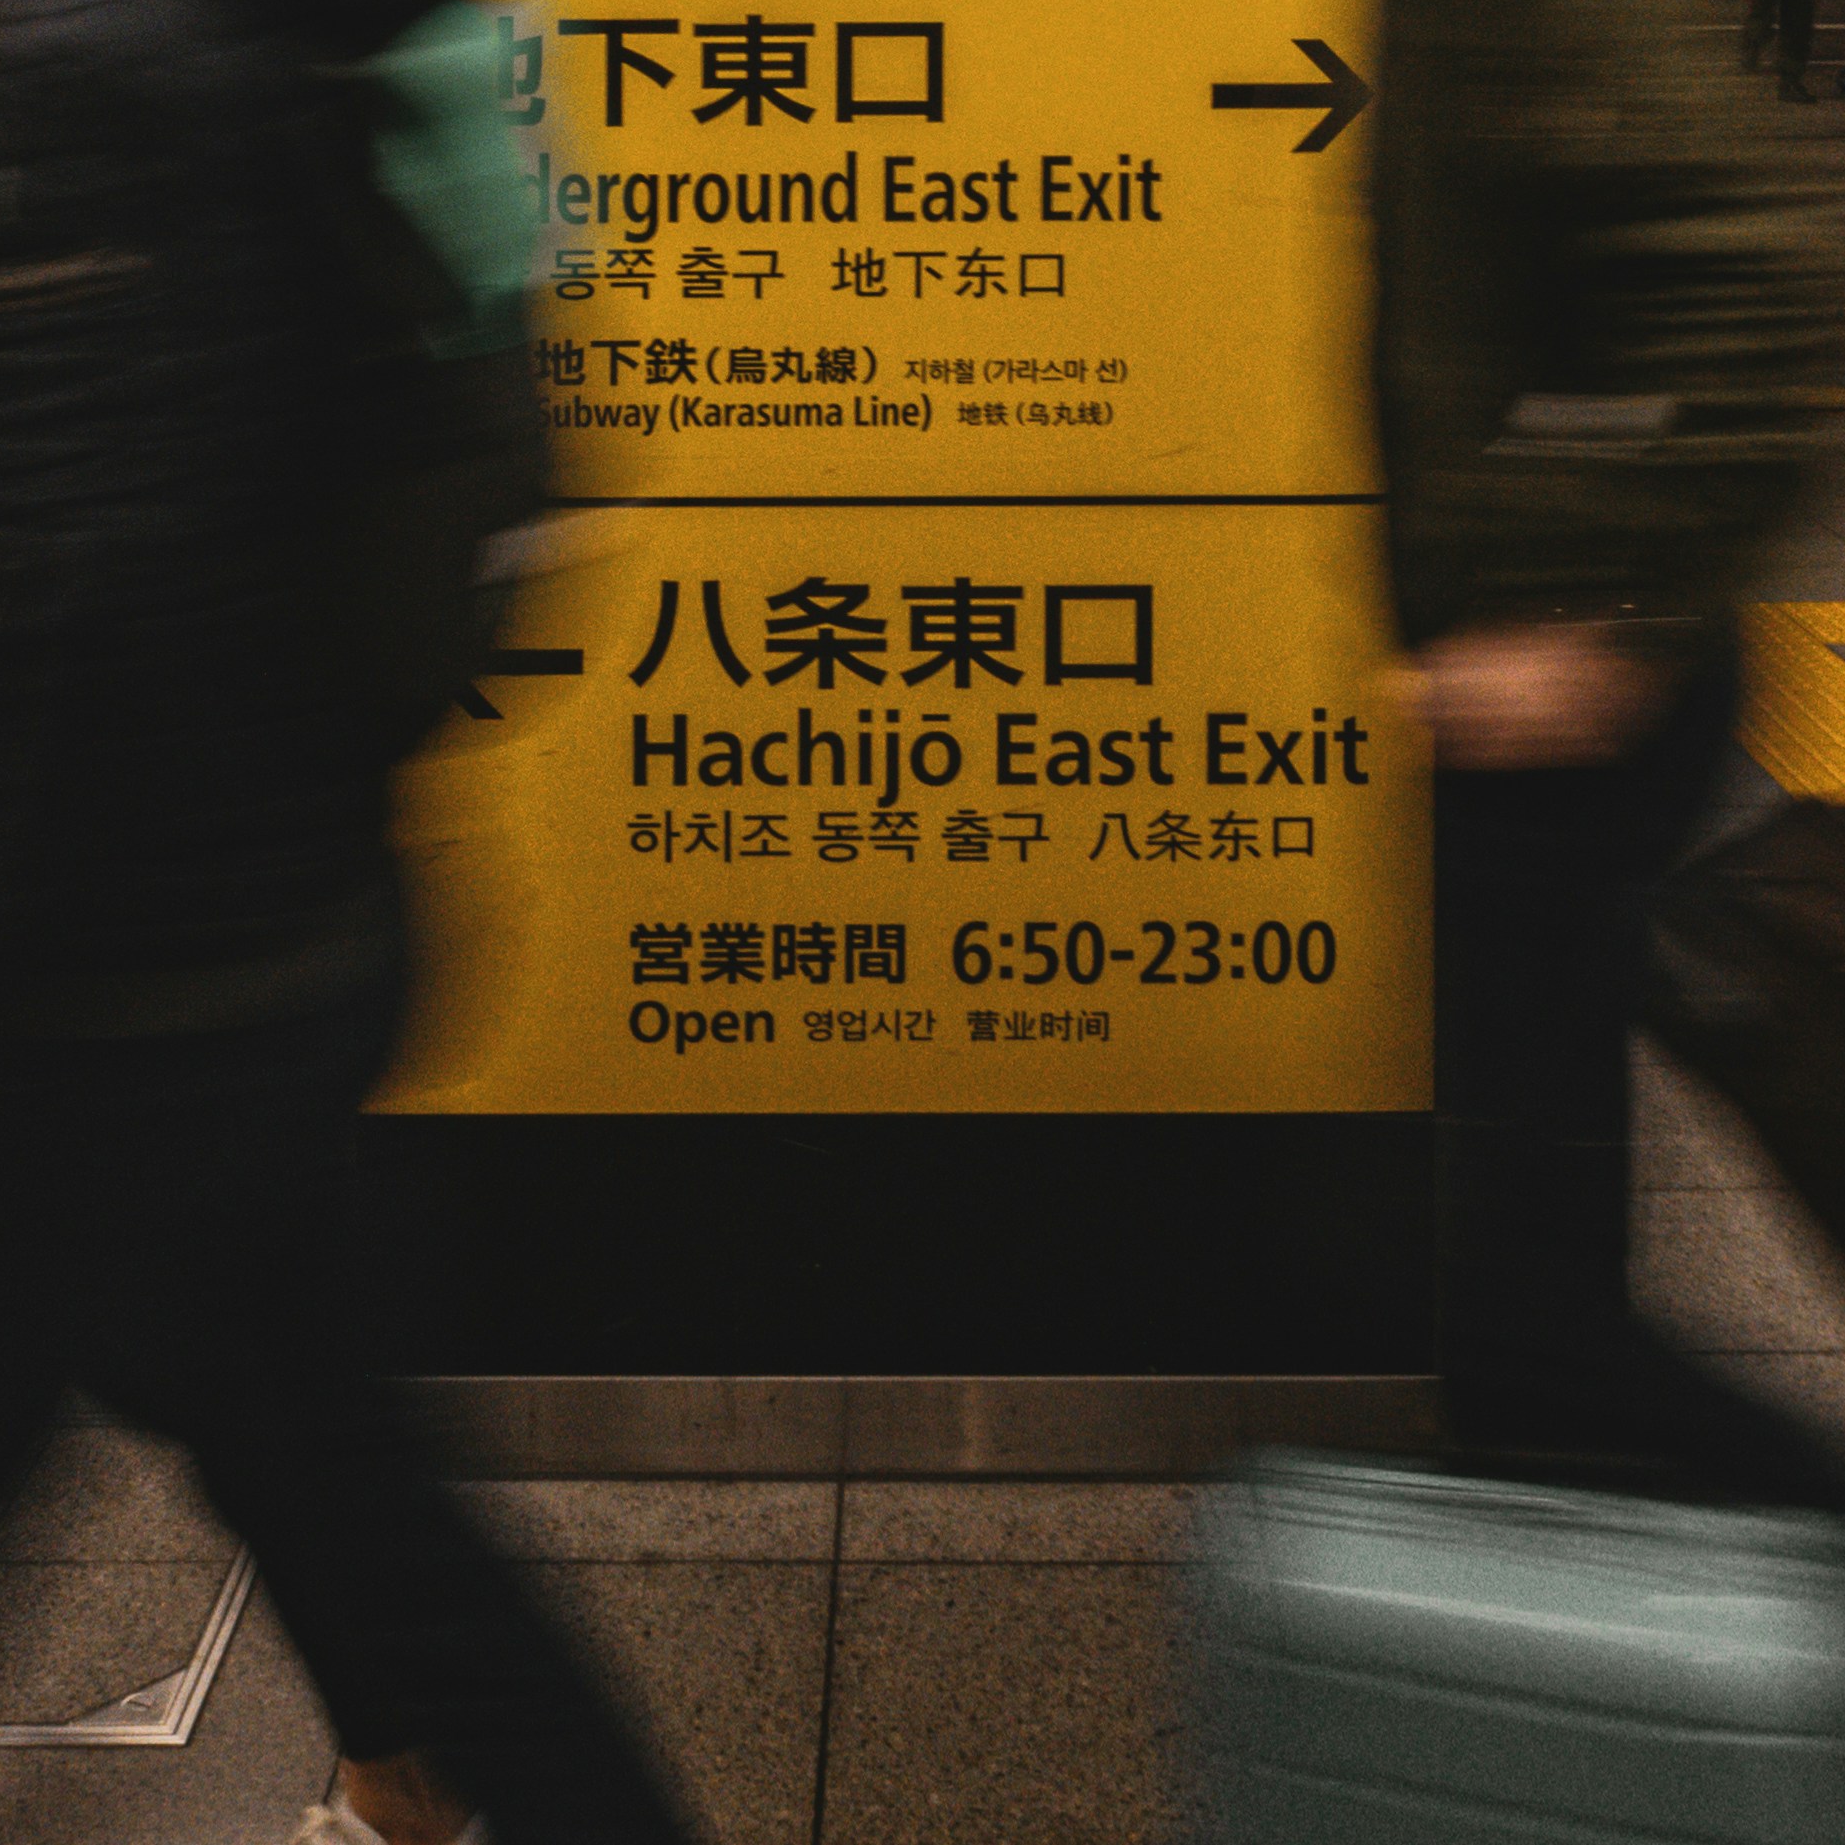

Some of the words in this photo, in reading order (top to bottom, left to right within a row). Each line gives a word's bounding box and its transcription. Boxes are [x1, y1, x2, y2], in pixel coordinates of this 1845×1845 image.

[526, 151, 858, 242] derground
[882, 157, 1017, 226] East
[1040, 152, 1161, 224] Exit
[551, 246, 655, 302] 동쪽
[676, 246, 785, 300] 출구
[831, 246, 1067, 299] 地下东口
[904, 358, 975, 385] 지하철
[668, 394, 842, 433] (Karasuma
[856, 393, 932, 431] Line)
[629, 576, 1155, 689] 八条東口
[631, 709, 961, 807] Hachijō
[994, 712, 1174, 786] East
[1205, 708, 1369, 786] Exit
[628, 810, 792, 862] 하치조
[812, 810, 920, 862] 동쪽
[941, 810, 1050, 862] 출구
[1088, 810, 1315, 862] 八条东口
[630, 923, 907, 986] 営業時間
[953, 921, 1336, 985] 6:50-23:00
[629, 1001, 775, 1054] Open
[803, 1009, 935, 1043] 영업시간
[967, 1009, 1110, 1043] 营业时间
